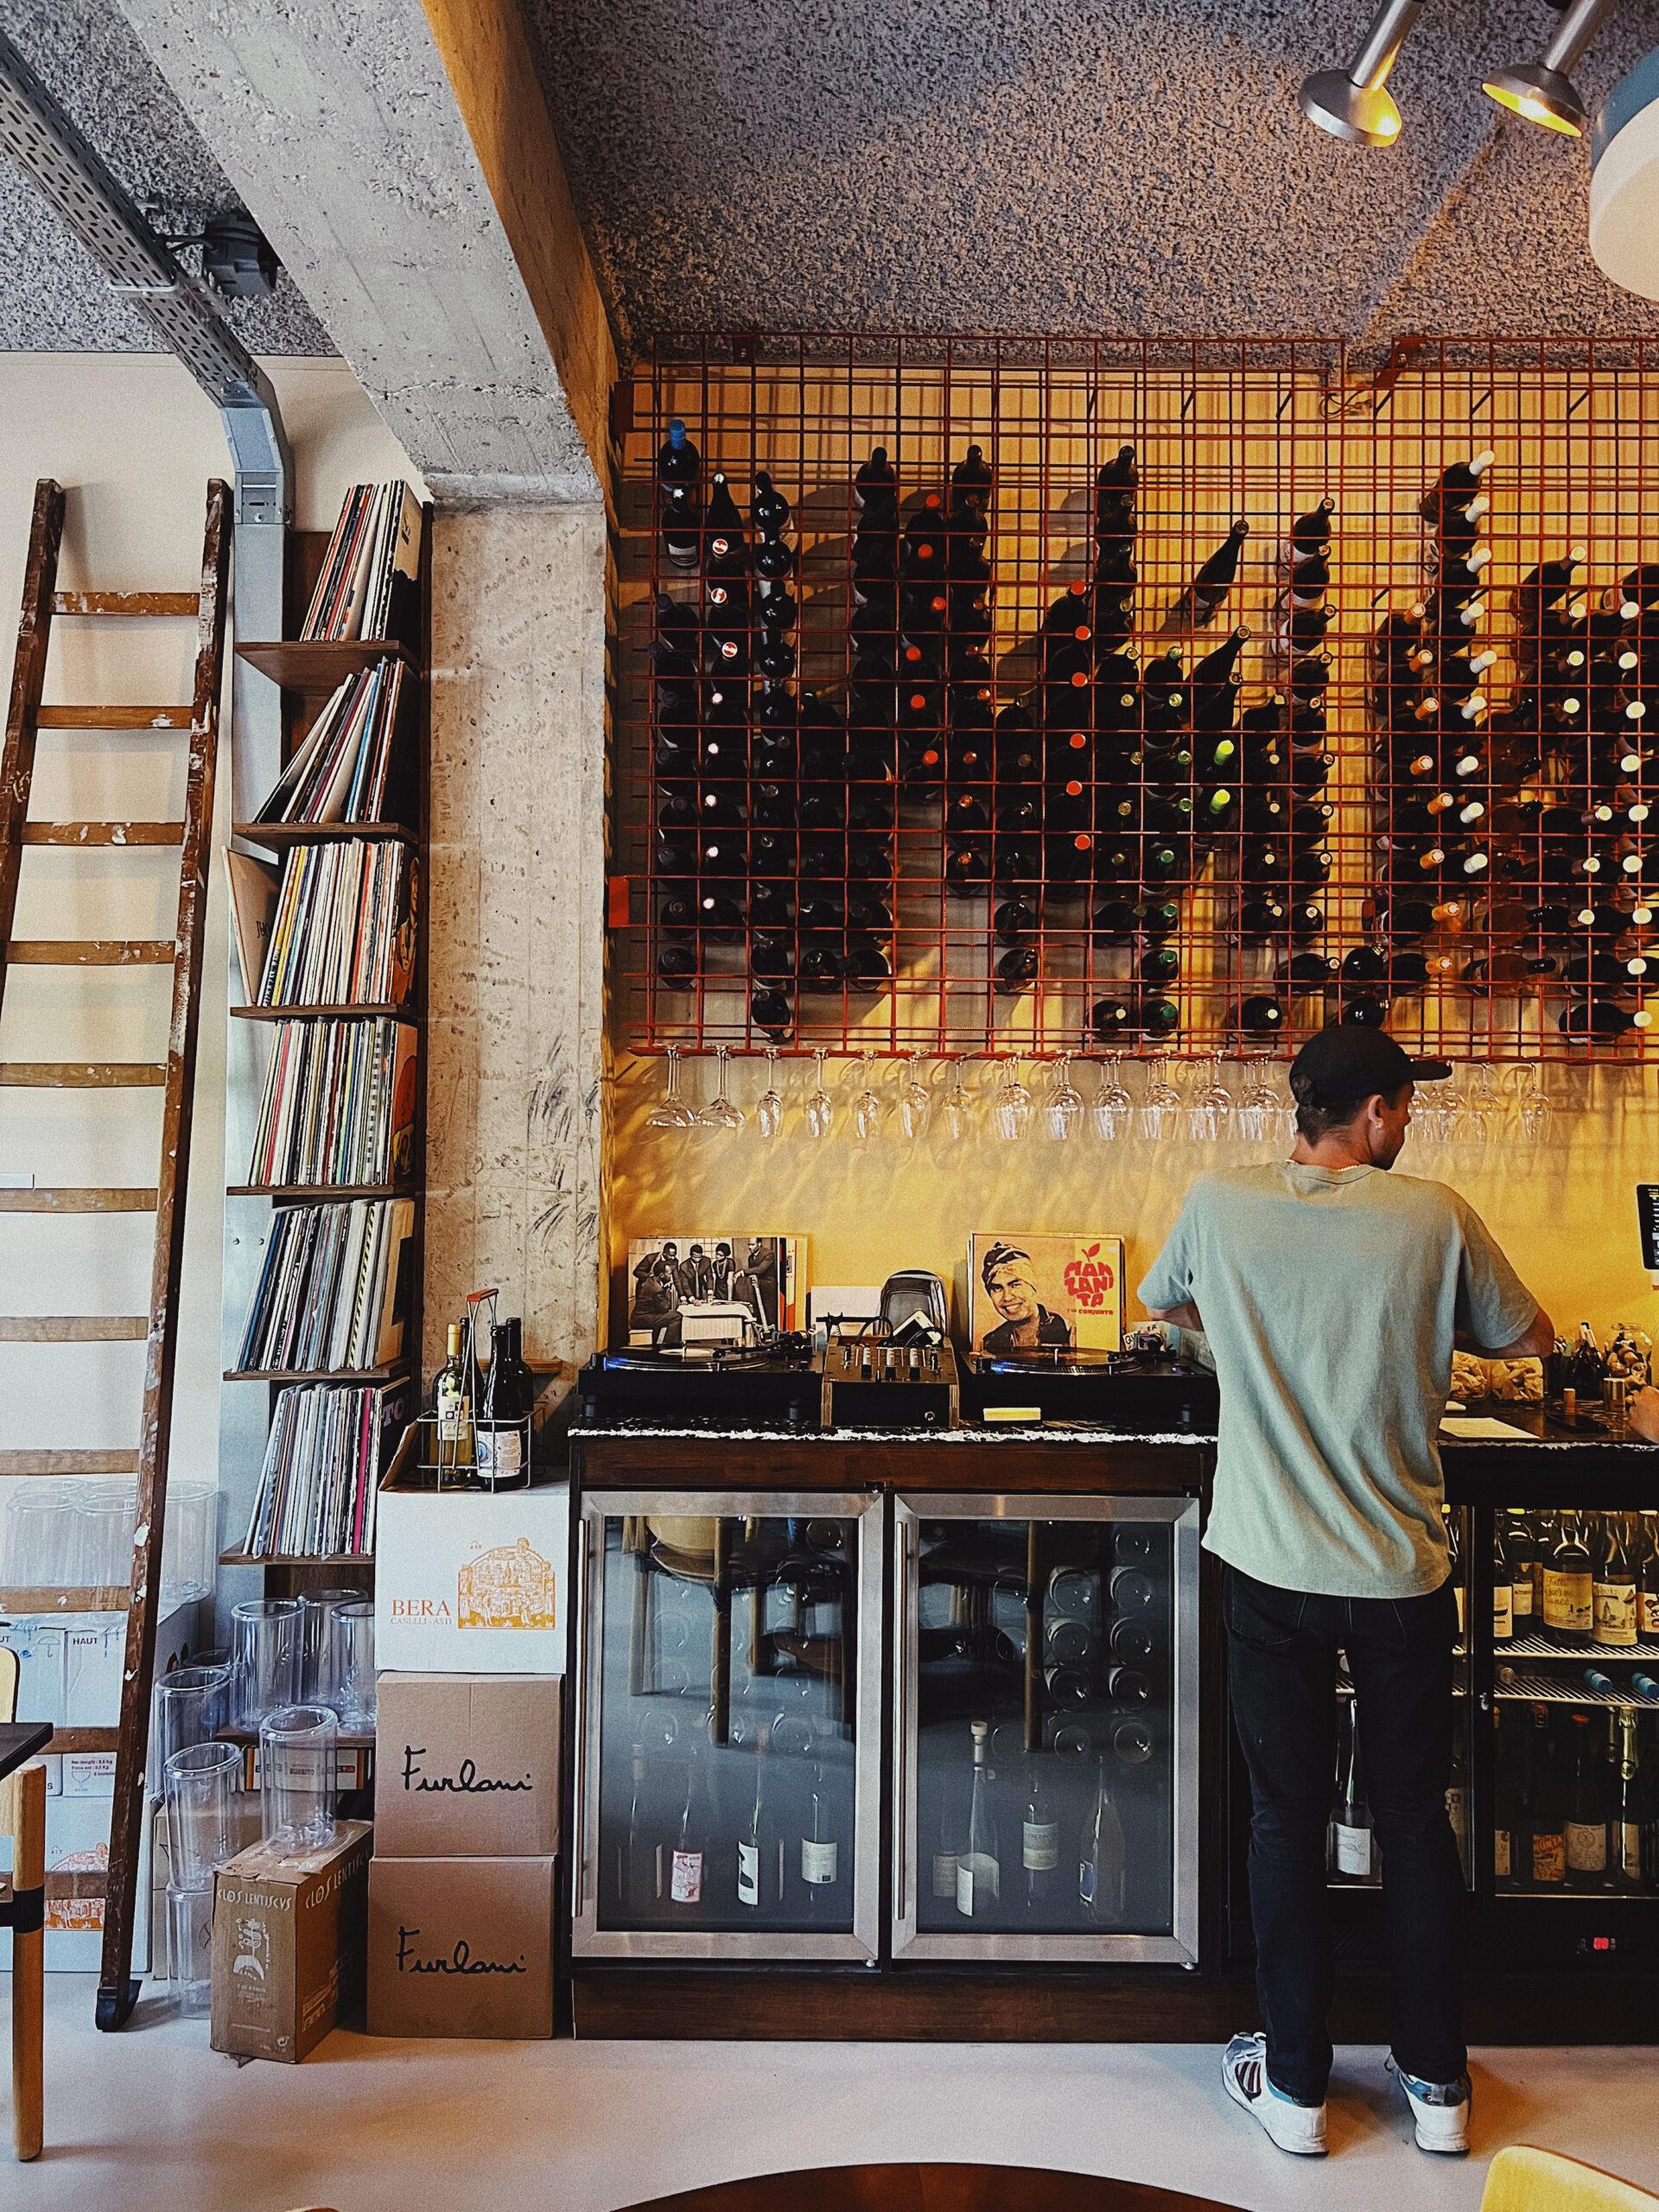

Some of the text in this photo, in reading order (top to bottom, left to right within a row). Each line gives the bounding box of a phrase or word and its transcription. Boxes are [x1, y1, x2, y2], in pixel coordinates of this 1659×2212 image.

[1064, 1261, 1114, 1279] MAN
[391, 1599, 450, 1617] BERA
[433, 1617, 452, 1625] ASTI
[73, 1637, 98, 1646] HAUT
[401, 1745, 533, 1792] Furlani
[217, 1889, 243, 1904] CLOS
[305, 1875, 332, 1909] CLOS
[396, 1925, 526, 1974] Furlani
